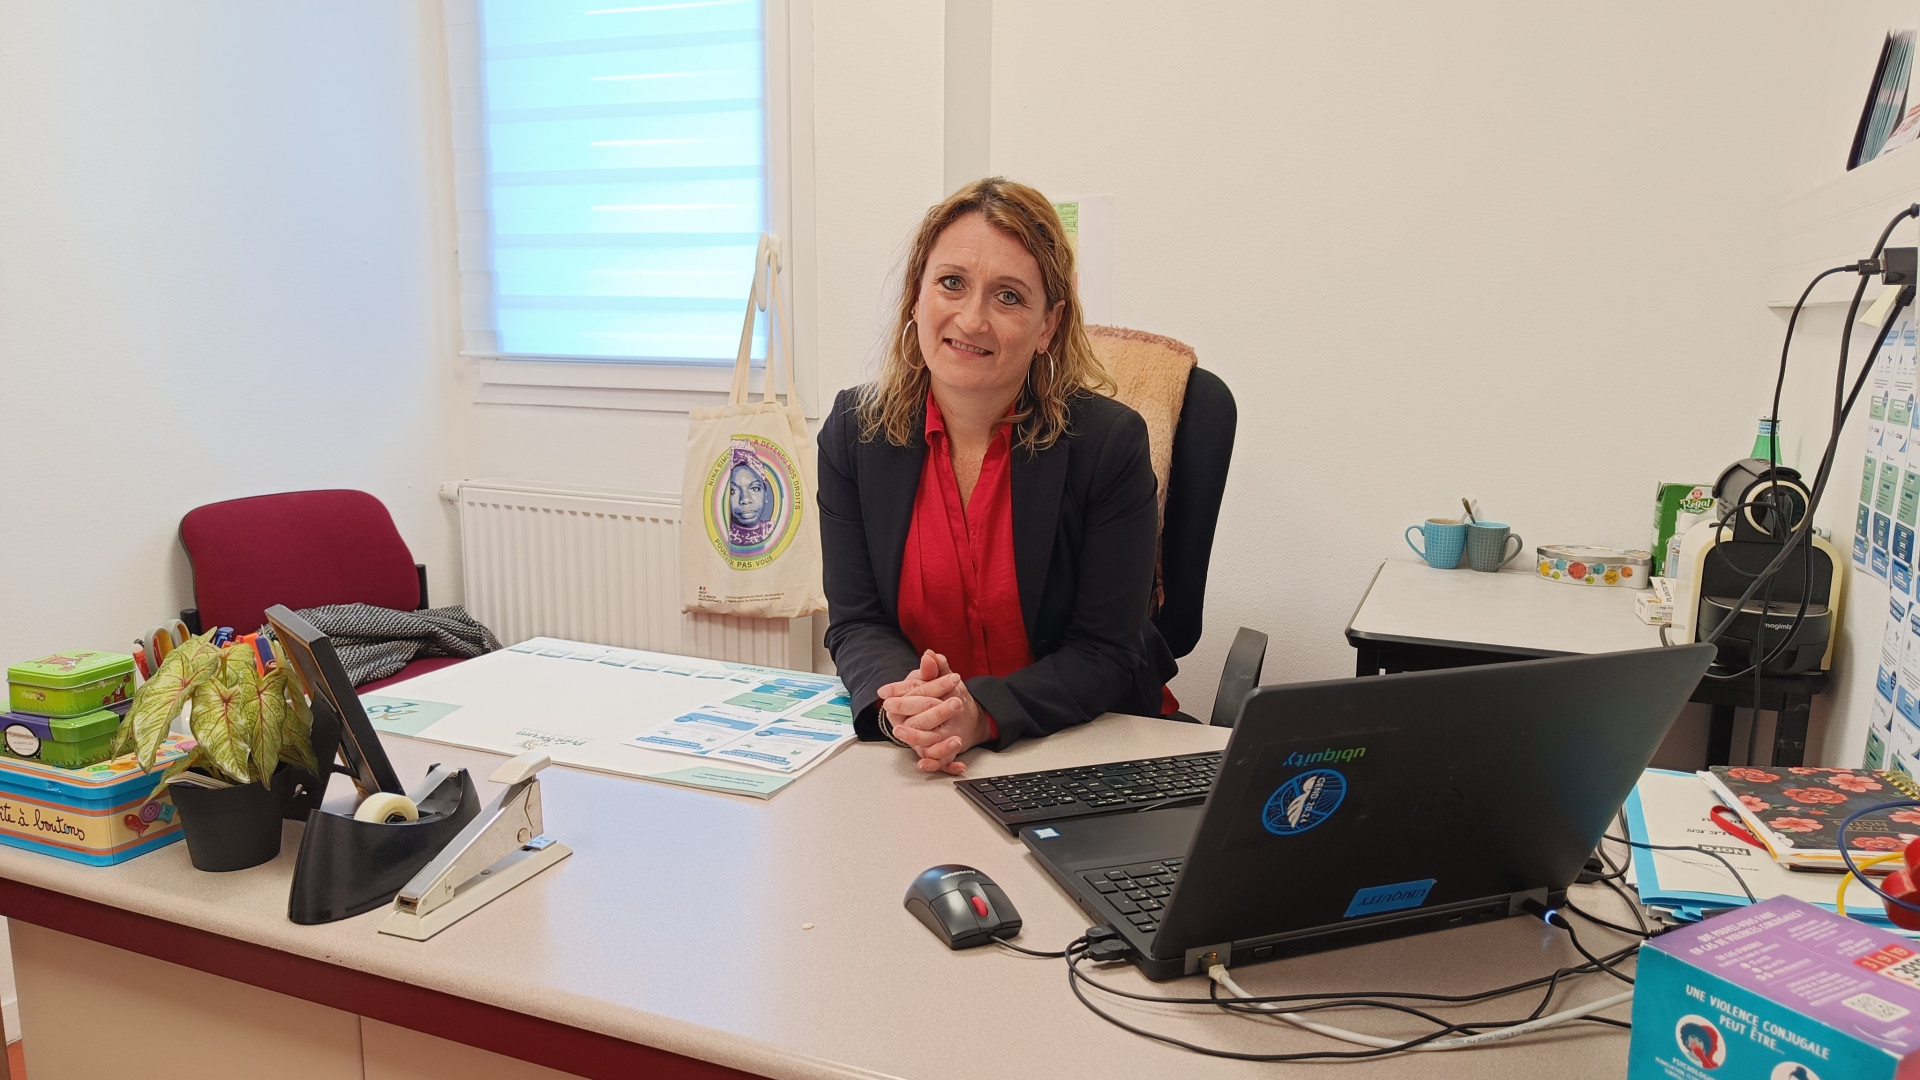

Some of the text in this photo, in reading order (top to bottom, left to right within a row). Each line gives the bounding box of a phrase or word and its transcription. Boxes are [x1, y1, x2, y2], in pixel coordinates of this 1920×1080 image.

[708, 453, 732, 487] NINA SIMO
[786, 463, 797, 480] NOS
[793, 480, 801, 510] DROITS
[755, 555, 773, 567] VOUS
[1282, 747, 1366, 767] ubiquity
[0, 802, 86, 841] îte à boutons
[1832, 820, 1888, 828] NOTS
[1701, 845, 1748, 855] Nora
[1357, 887, 1427, 907] UBIQUITY
[1685, 984, 1831, 1060] UNE VIOLENCE CONJUGALE
[1719, 1015, 1748, 1036] PEUT
